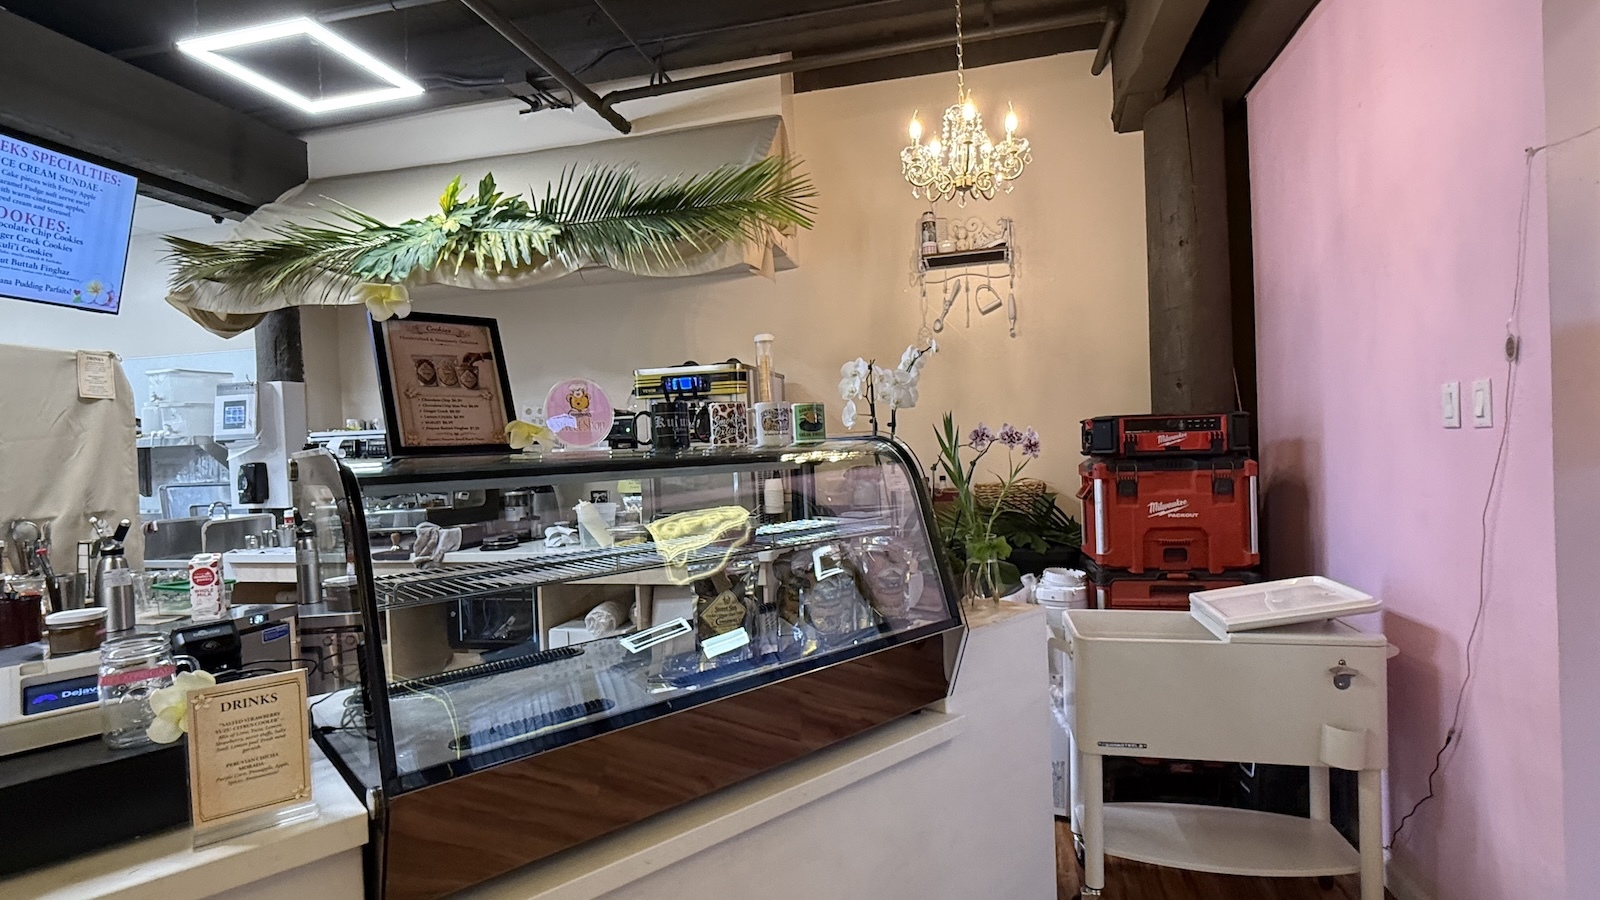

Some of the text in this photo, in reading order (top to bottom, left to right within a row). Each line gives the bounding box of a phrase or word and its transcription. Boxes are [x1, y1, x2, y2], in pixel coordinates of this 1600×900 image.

[32, 150, 121, 186] SPECIALTIES:
[1, 169, 96, 200] Cake pieces with Frosty Apple
[19, 162, 56, 179] CREAM
[60, 174, 99, 192] SUNDAE
[24, 184, 44, 195] Fudge
[46, 190, 57, 198] soft
[59, 195, 75, 203] serve
[12, 199, 32, 207] cream
[33, 204, 46, 212] and
[16, 234, 40, 246] Crack
[43, 240, 73, 252] Cookies
[31, 227, 51, 239] Chip
[54, 232, 84, 245] Cookies
[22, 245, 53, 258] Cookies
[11, 258, 38, 270] Buttah
[15, 279, 43, 292] Pudding
[45, 284, 72, 295] Parfaits!
[1157, 432, 1187, 444] Milwaukee
[1147, 499, 1188, 513] Milwaukee
[221, 693, 278, 712] DRINKS
[226, 758, 255, 768] PERUVIAN
[239, 762, 264, 770] MORADA
